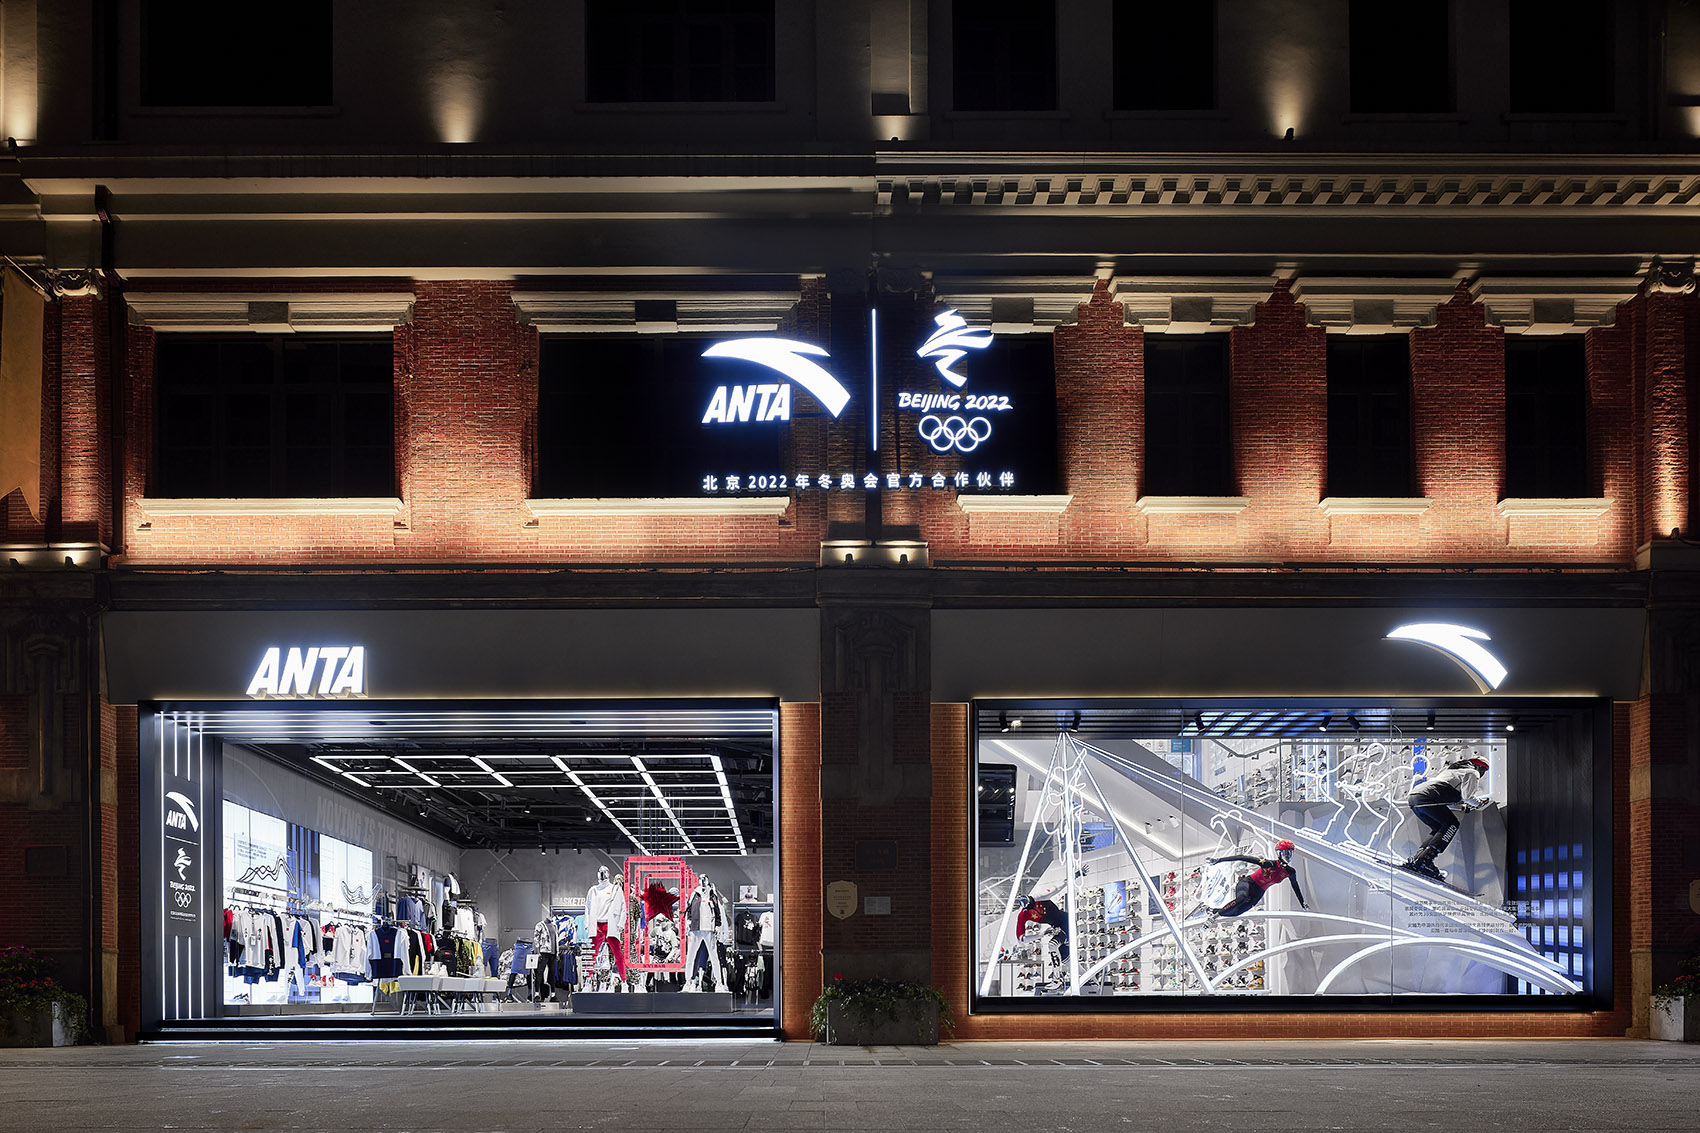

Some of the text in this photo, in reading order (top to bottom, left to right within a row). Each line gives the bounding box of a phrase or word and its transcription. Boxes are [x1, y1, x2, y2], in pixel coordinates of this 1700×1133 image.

[701, 383, 791, 424] ANTA
[898, 392, 1014, 413] BEIJING 2022
[246, 646, 366, 697] ANTA
[166, 809, 187, 831] ANTA
